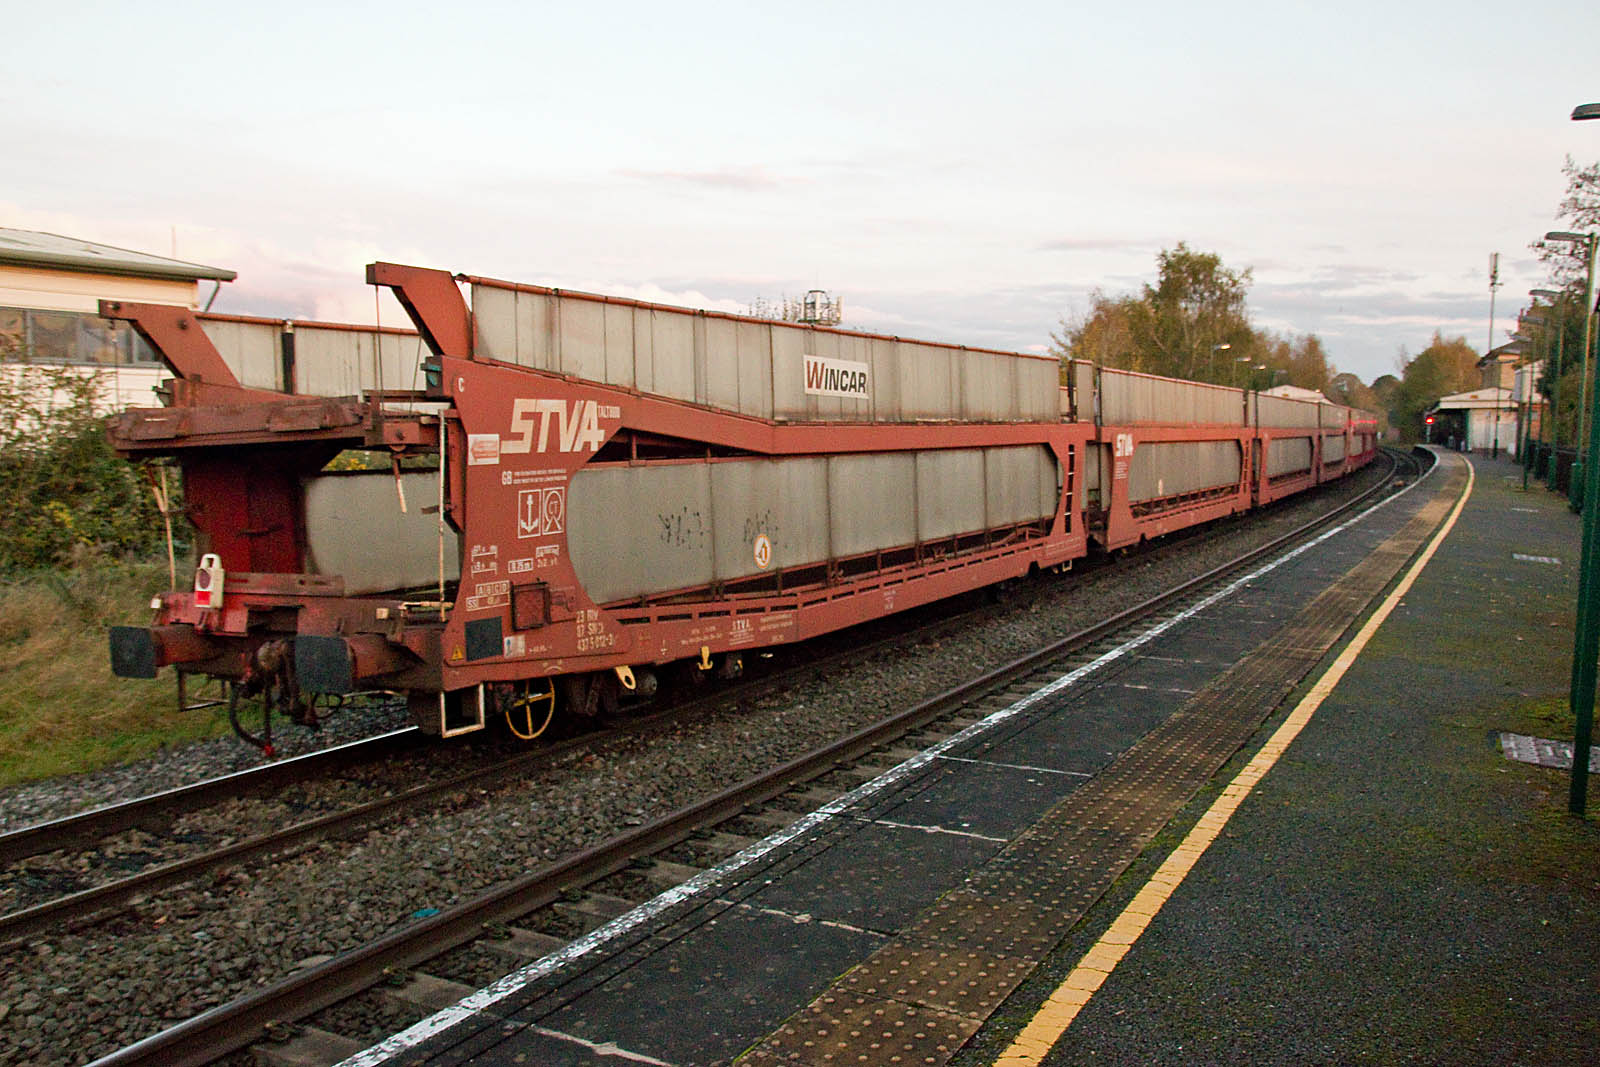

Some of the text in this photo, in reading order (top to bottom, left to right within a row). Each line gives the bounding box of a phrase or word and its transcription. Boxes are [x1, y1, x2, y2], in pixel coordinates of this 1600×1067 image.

[458, 377, 464, 392] C
[807, 360, 866, 394] WINCAR
[500, 398, 605, 453] STVA
